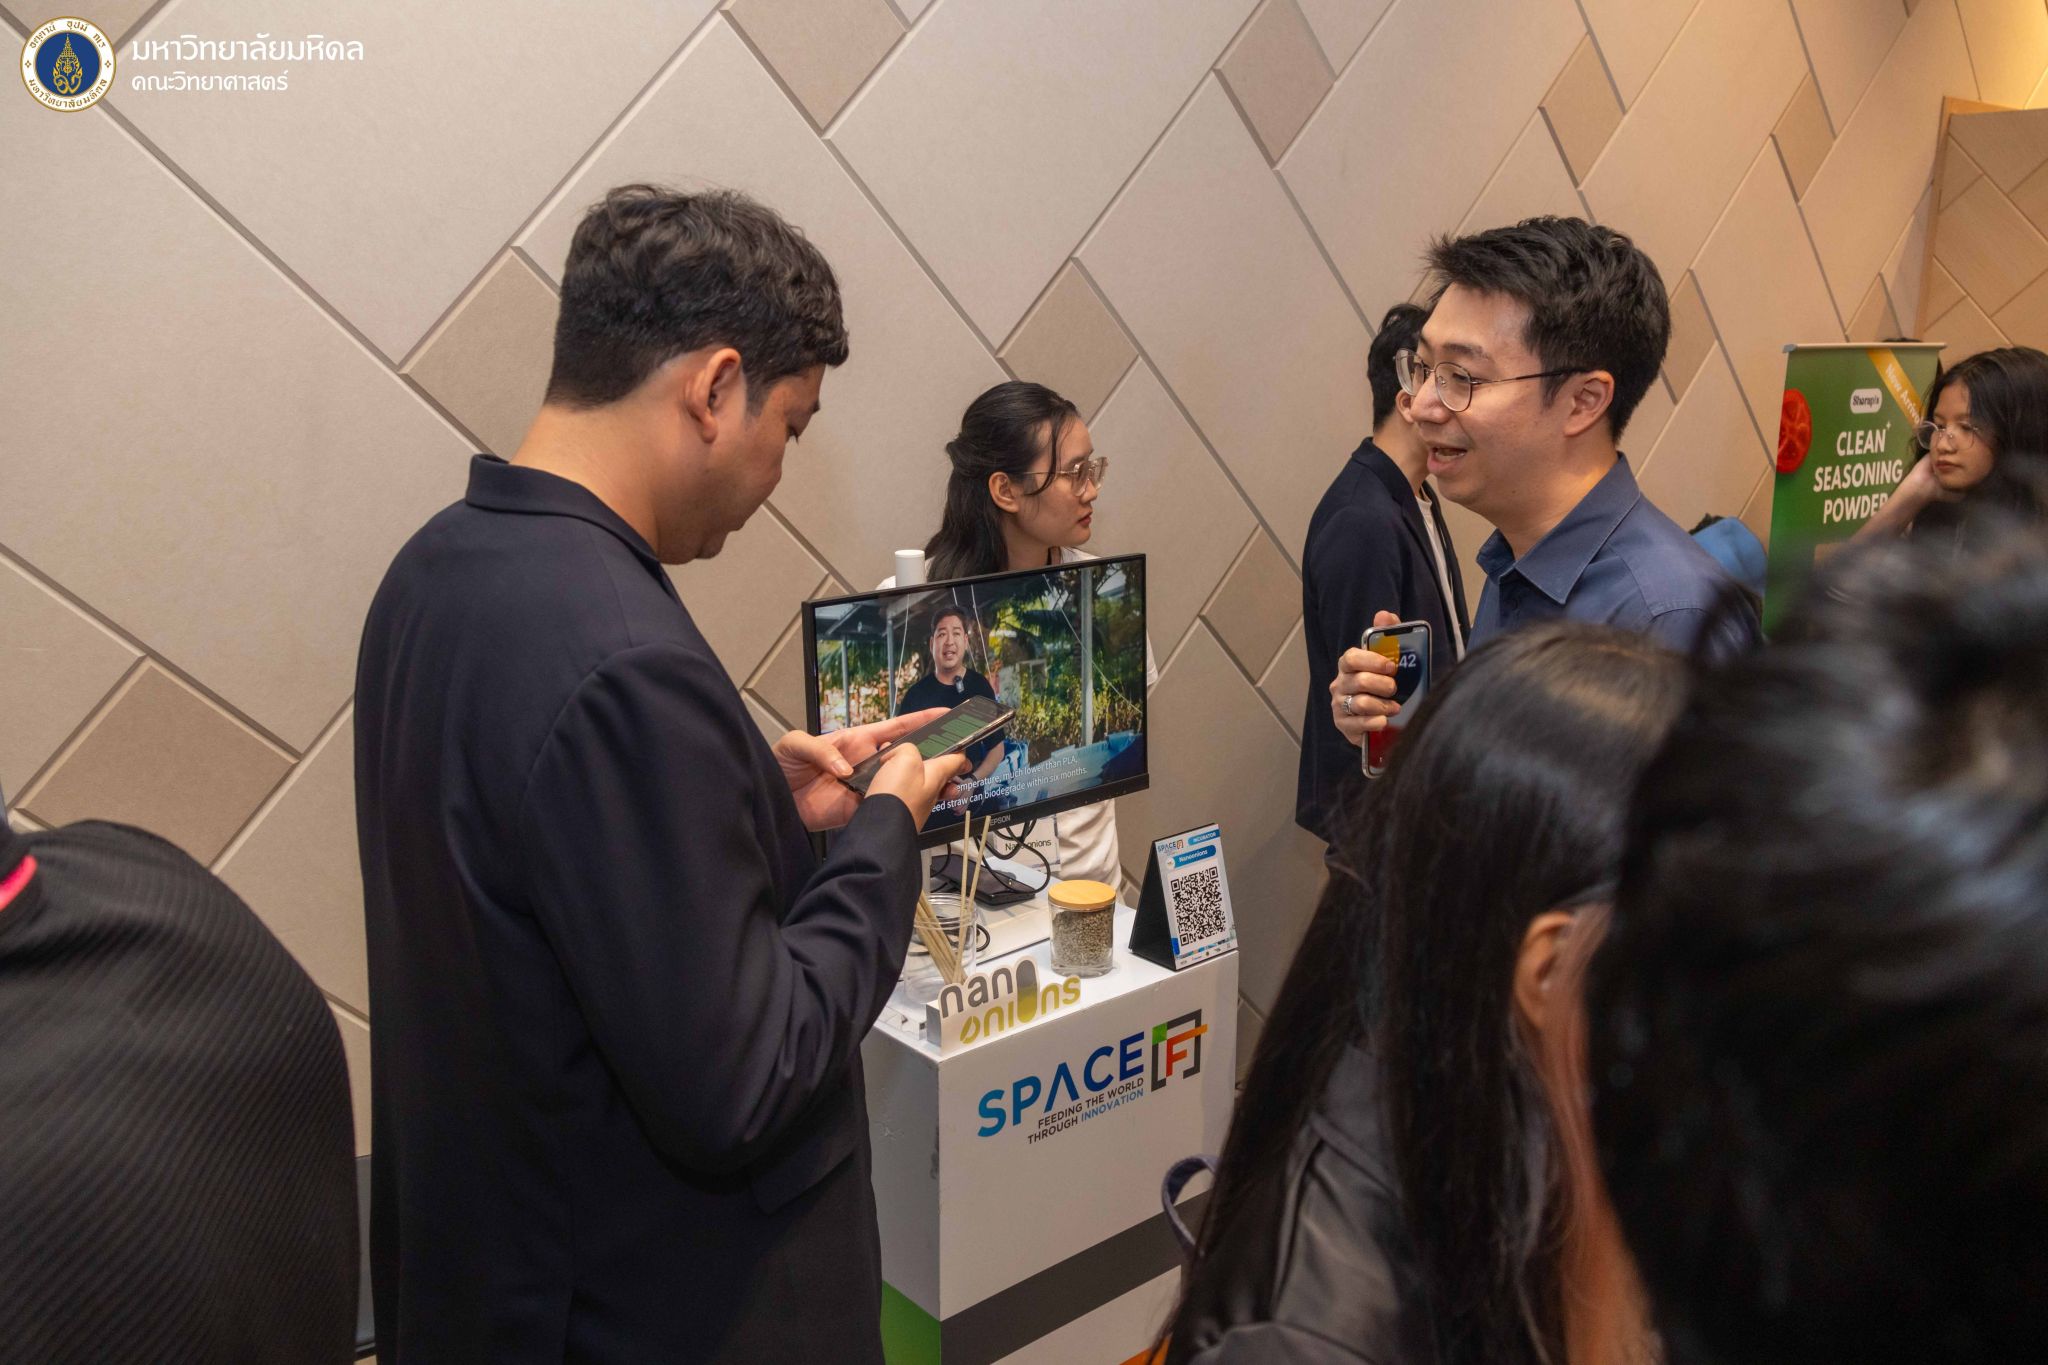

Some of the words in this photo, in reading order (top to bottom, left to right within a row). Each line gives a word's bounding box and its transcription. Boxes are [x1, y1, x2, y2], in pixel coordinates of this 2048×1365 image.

[1836, 428, 1887, 457] CLEAN
[1813, 458, 1903, 493] SEASONING
[931, 800, 946, 813] eed
[946, 797, 969, 809] straw
[969, 793, 983, 803] can
[984, 782, 1026, 800] biodegrade
[1026, 775, 1049, 789] within
[1049, 773, 1060, 783] six
[1060, 766, 1088, 780] months.
[956, 772, 1002, 793] emperature,
[1002, 769, 1023, 781] much
[1024, 763, 1044, 776] lower
[1045, 758, 1062, 770] than
[1062, 754, 1078, 766] PLA,
[990, 814, 1011, 826] EPSON
[1005, 839, 1052, 851] Naonions
[977, 1031, 1145, 1137] SPACE
[1038, 1102, 1083, 1129] FEEDING
[1085, 1093, 1105, 1109] THE
[1107, 1077, 1144, 1099] WORLD
[1027, 1116, 1078, 1145] THROUGH
[1081, 1088, 1144, 1121] INNOVATION
